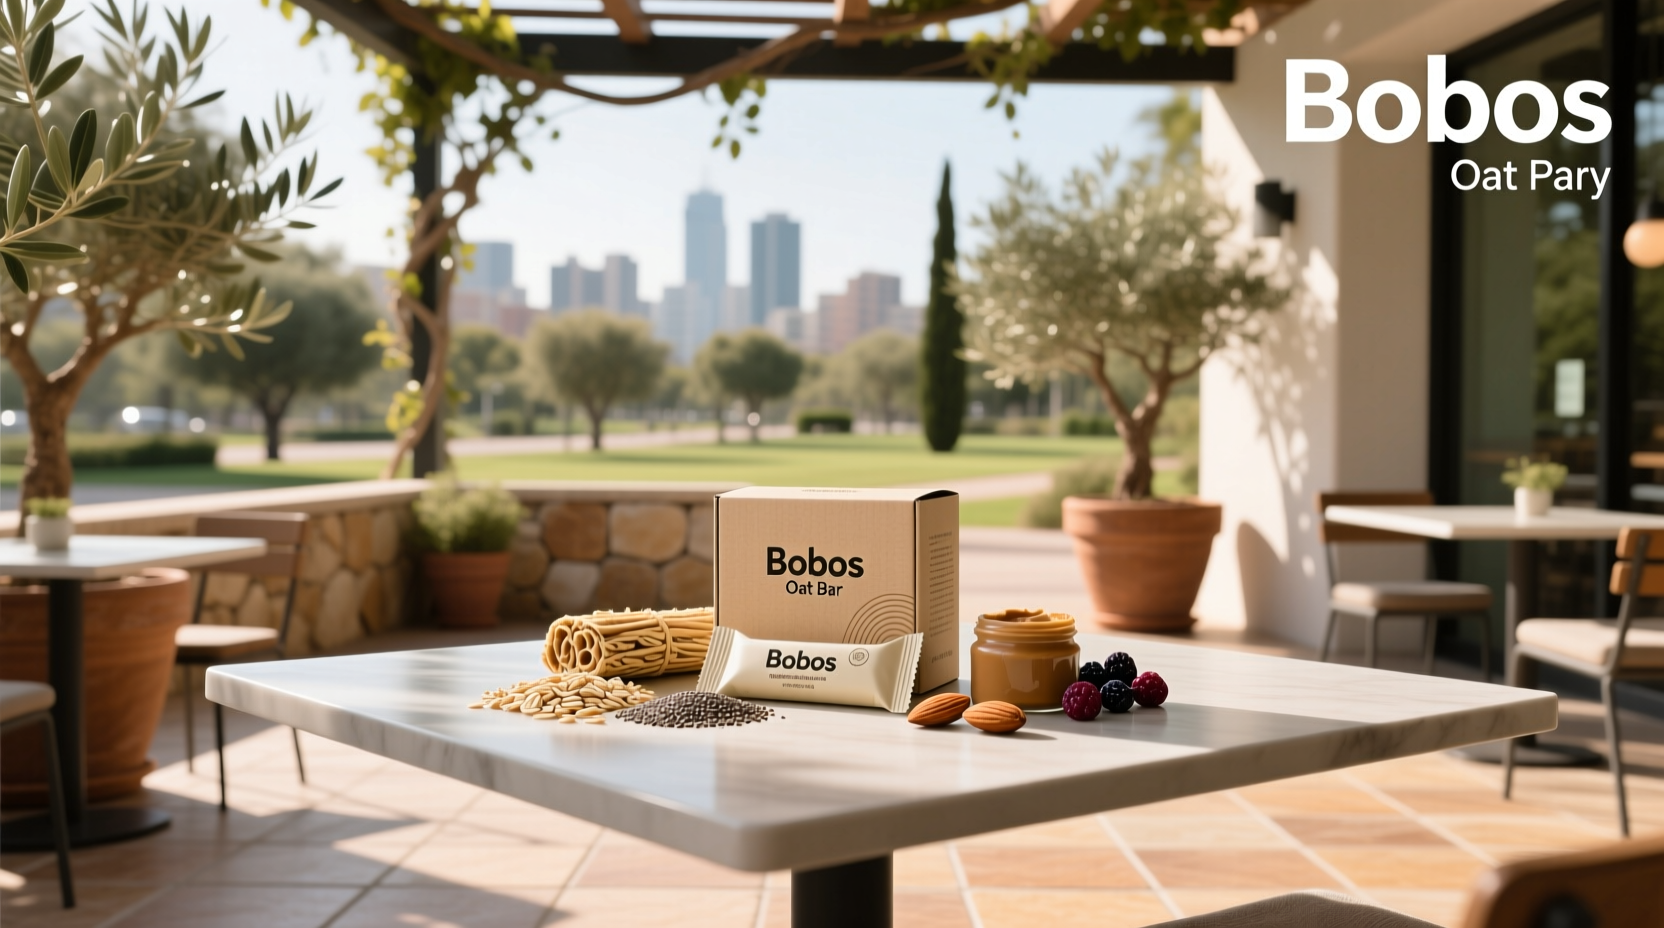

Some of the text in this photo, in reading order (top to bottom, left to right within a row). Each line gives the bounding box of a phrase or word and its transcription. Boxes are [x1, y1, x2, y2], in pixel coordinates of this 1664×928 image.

[766, 546, 864, 578] Bobos
[785, 580, 843, 597] Oat Bar
[765, 649, 837, 672] Bobos
